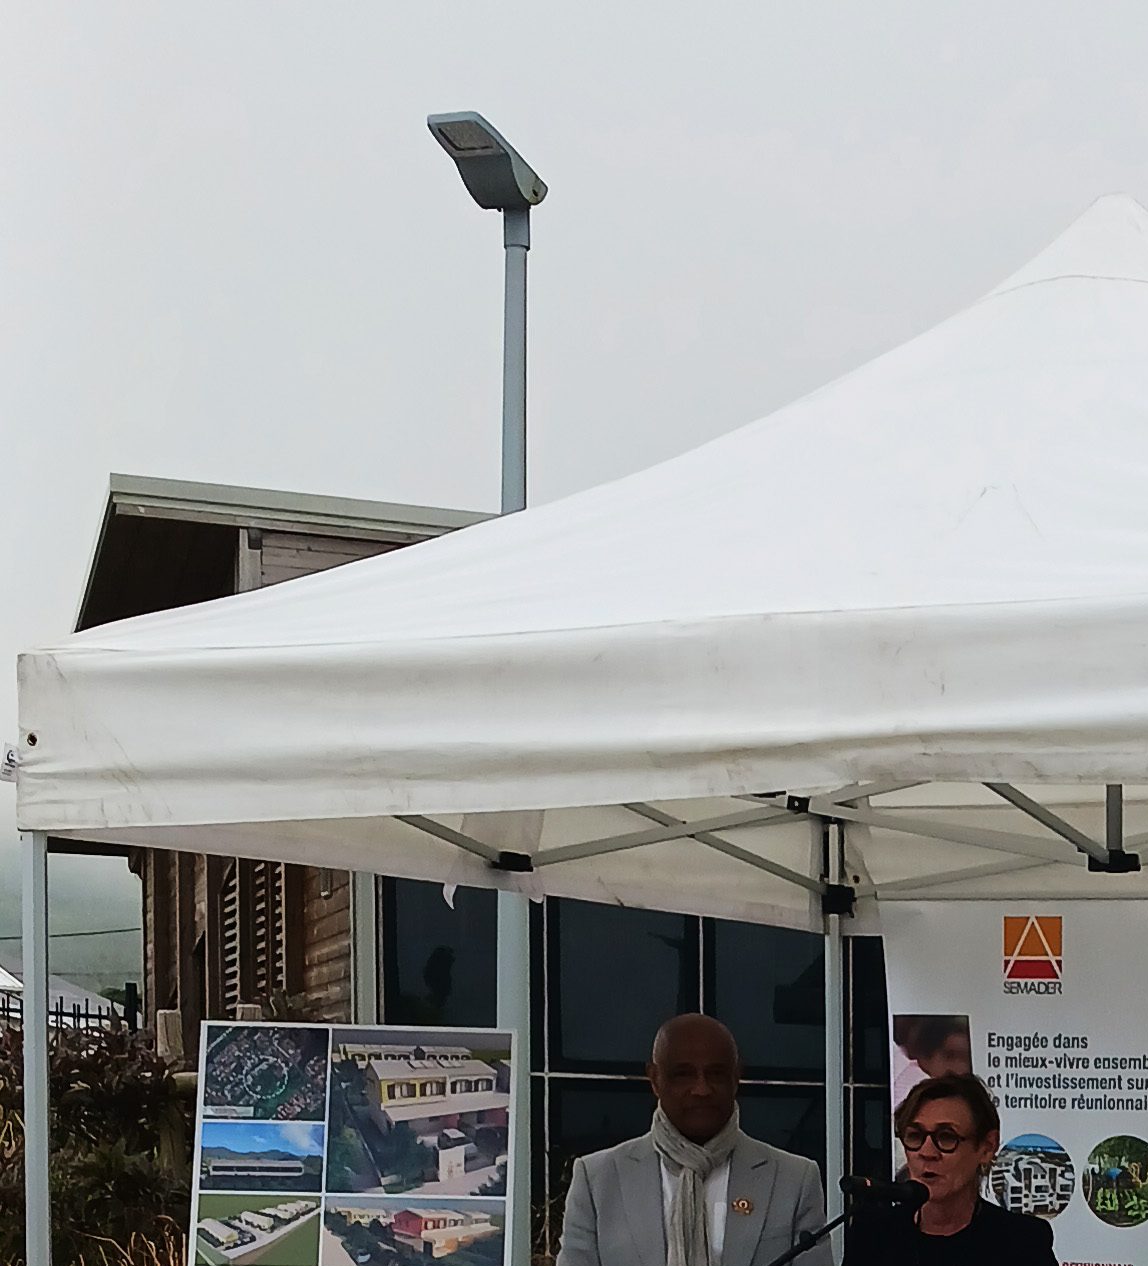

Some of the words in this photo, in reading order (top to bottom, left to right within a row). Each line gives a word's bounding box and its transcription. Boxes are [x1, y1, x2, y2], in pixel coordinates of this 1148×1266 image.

[1003, 980, 1063, 995] SEMADER
[987, 1032, 1048, 1051] Engagée
[1053, 1033, 1088, 1049] dans
[987, 1053, 1001, 1068] le
[1005, 1053, 1090, 1069] mieux-vivre
[987, 1074, 1002, 1088] et
[1006, 1073, 1123, 1090] l'investissement
[1005, 1093, 1067, 1109] territoire
